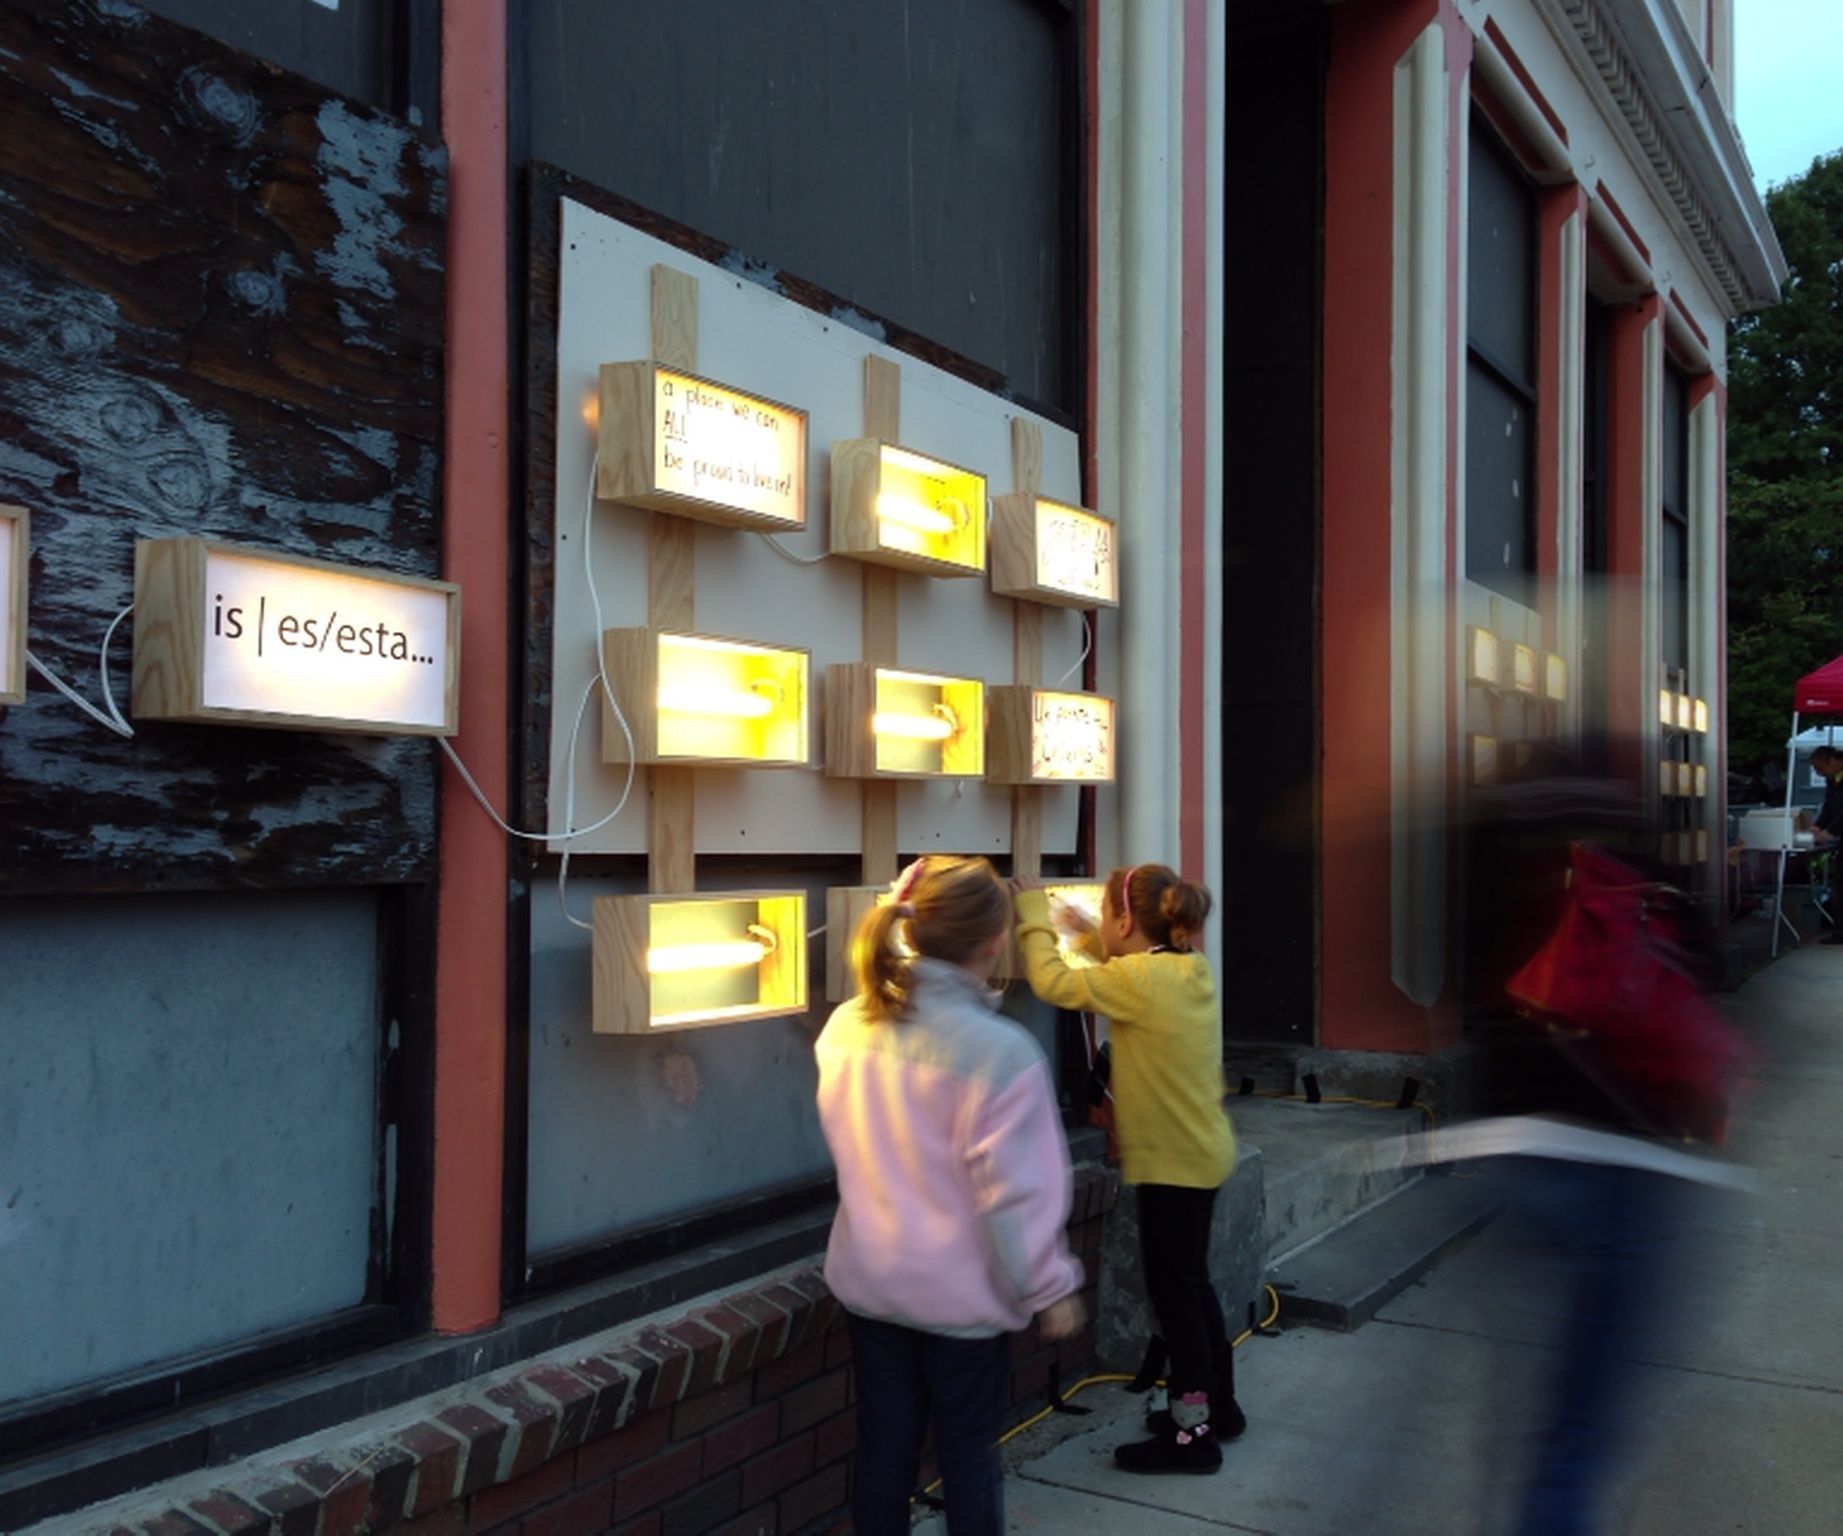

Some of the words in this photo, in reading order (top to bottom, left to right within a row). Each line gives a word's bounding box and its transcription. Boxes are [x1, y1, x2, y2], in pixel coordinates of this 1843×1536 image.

[662, 380, 674, 396] a
[664, 444, 683, 470] be
[213, 594, 243, 638] is
[278, 611, 433, 664] es/esta...
